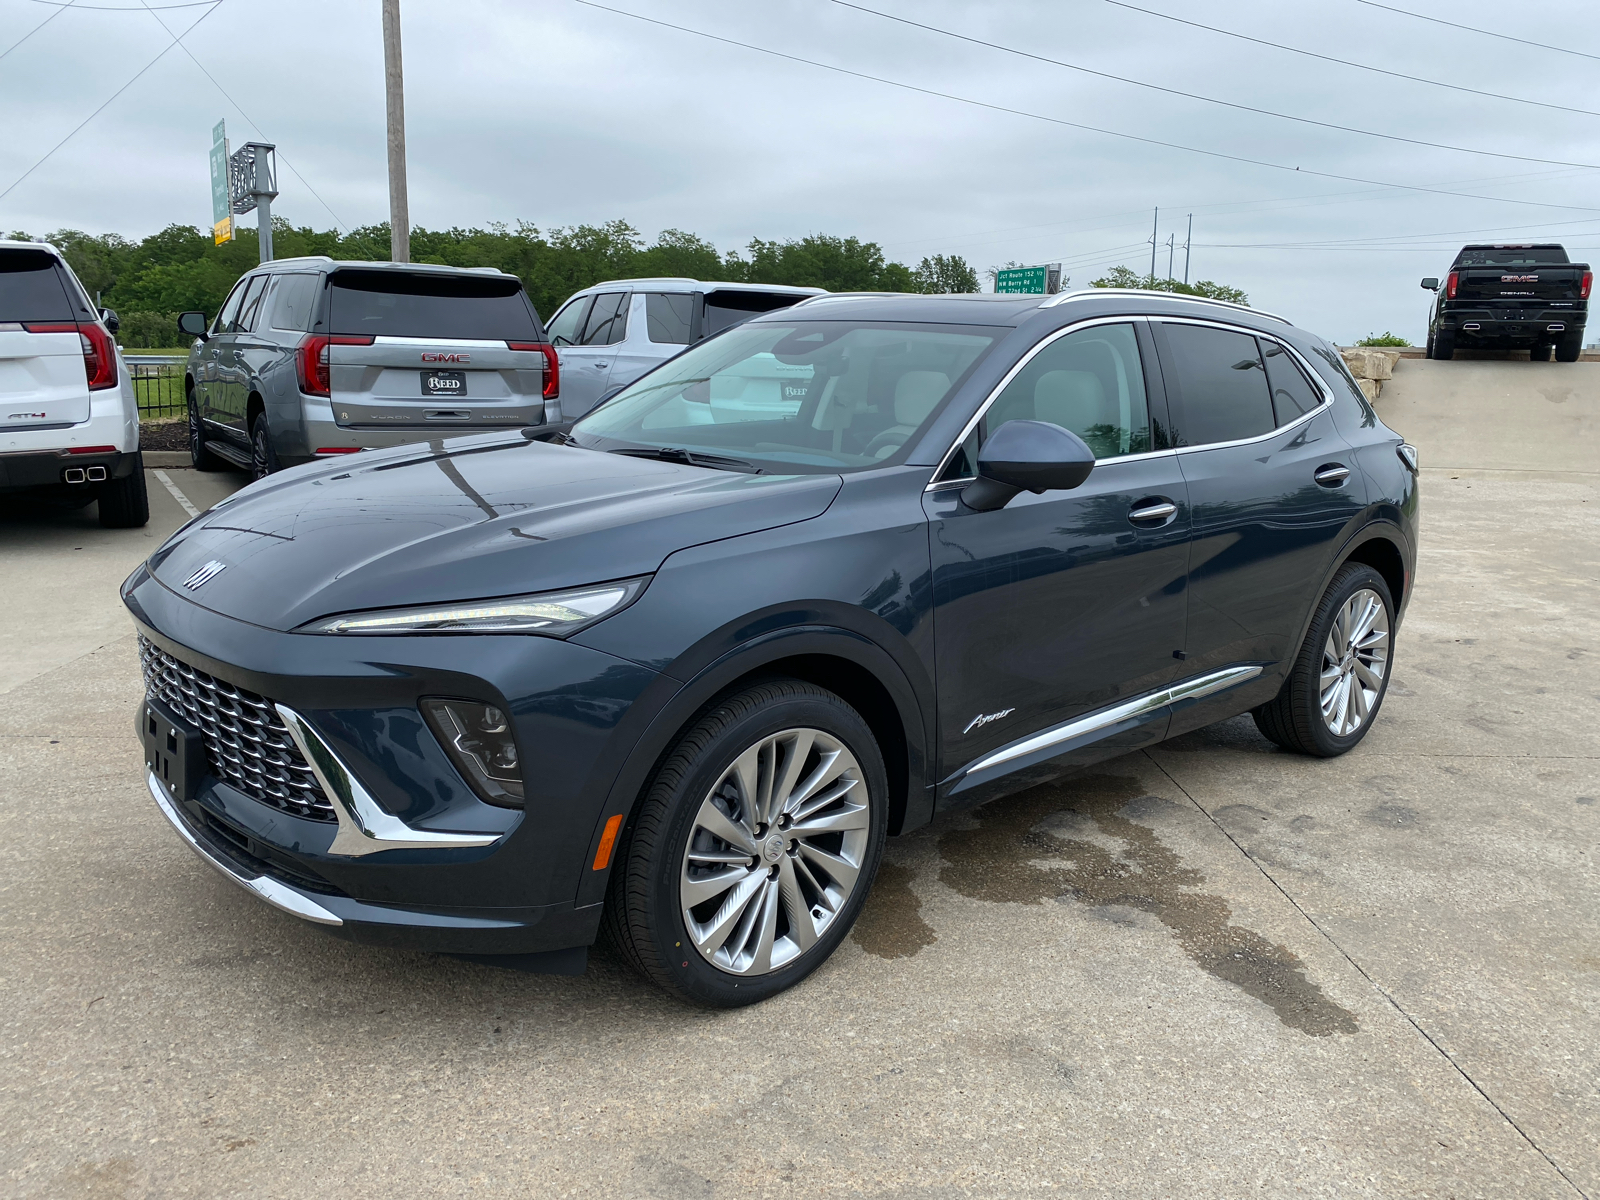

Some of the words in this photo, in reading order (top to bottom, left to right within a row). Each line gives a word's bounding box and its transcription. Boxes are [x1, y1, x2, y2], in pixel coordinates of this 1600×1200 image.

[1501, 275, 1539, 283] GMC
[421, 352, 471, 364] GMC
[428, 376, 460, 390] REED
[7, 411, 46, 420] AT4
[962, 707, 1016, 735] Avenir
